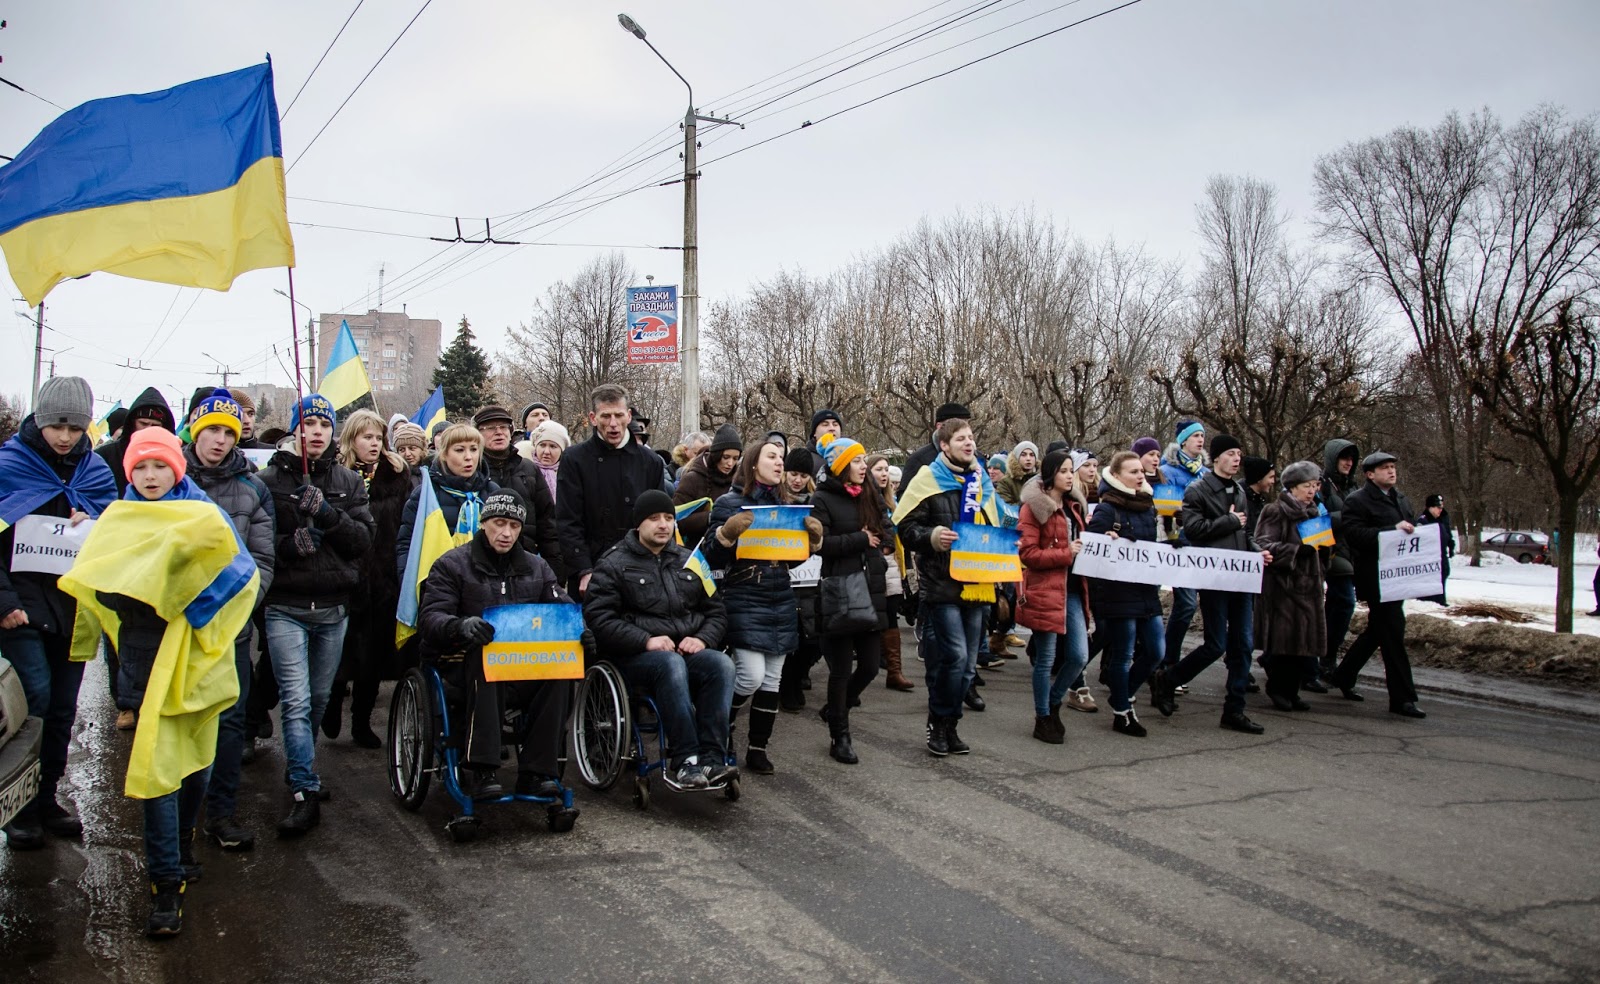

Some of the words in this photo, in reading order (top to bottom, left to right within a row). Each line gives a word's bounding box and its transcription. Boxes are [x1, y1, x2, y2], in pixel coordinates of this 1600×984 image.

[634, 292, 669, 302] ЗАКАЖИ
[630, 302, 674, 313] ПРАЗДНИК
[769, 510, 778, 521] Я
[52, 523, 65, 536] Я
[982, 534, 990, 544] Я
[953, 560, 1017, 571] ВОЛНОВАХА
[1380, 562, 1441, 580] ВОЛНОВАХА
[531, 617, 542, 630] Я
[487, 651, 577, 665] ВОЛНОВАХА
